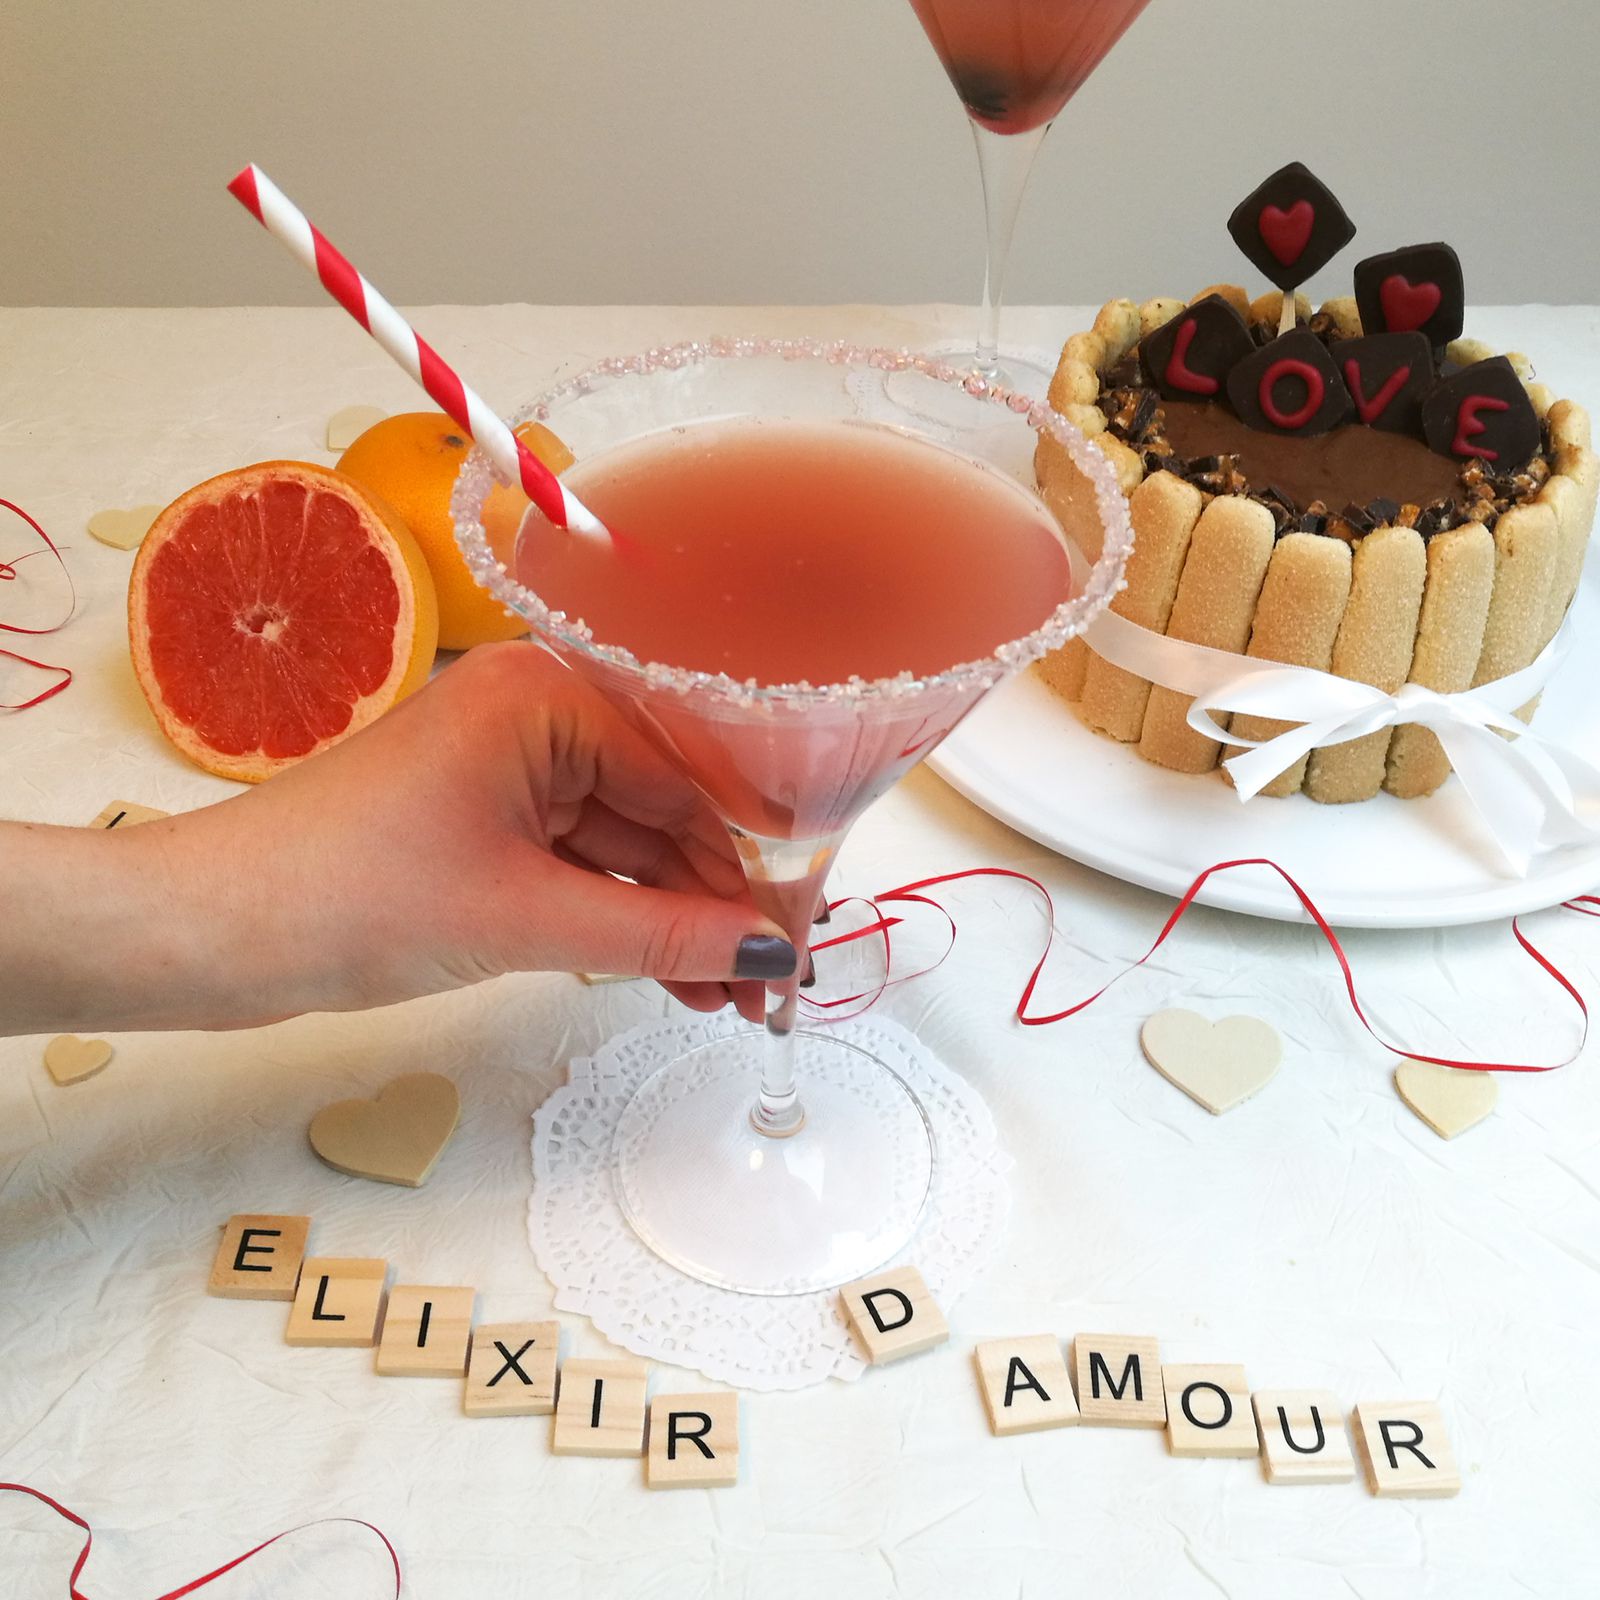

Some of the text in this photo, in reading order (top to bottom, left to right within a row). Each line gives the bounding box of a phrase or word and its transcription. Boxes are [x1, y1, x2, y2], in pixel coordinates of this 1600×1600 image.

[1164, 318, 1510, 461] LOVE
[232, 1228, 716, 1460] ELIXIR
[861, 1288, 1436, 1469] D AMOUR
